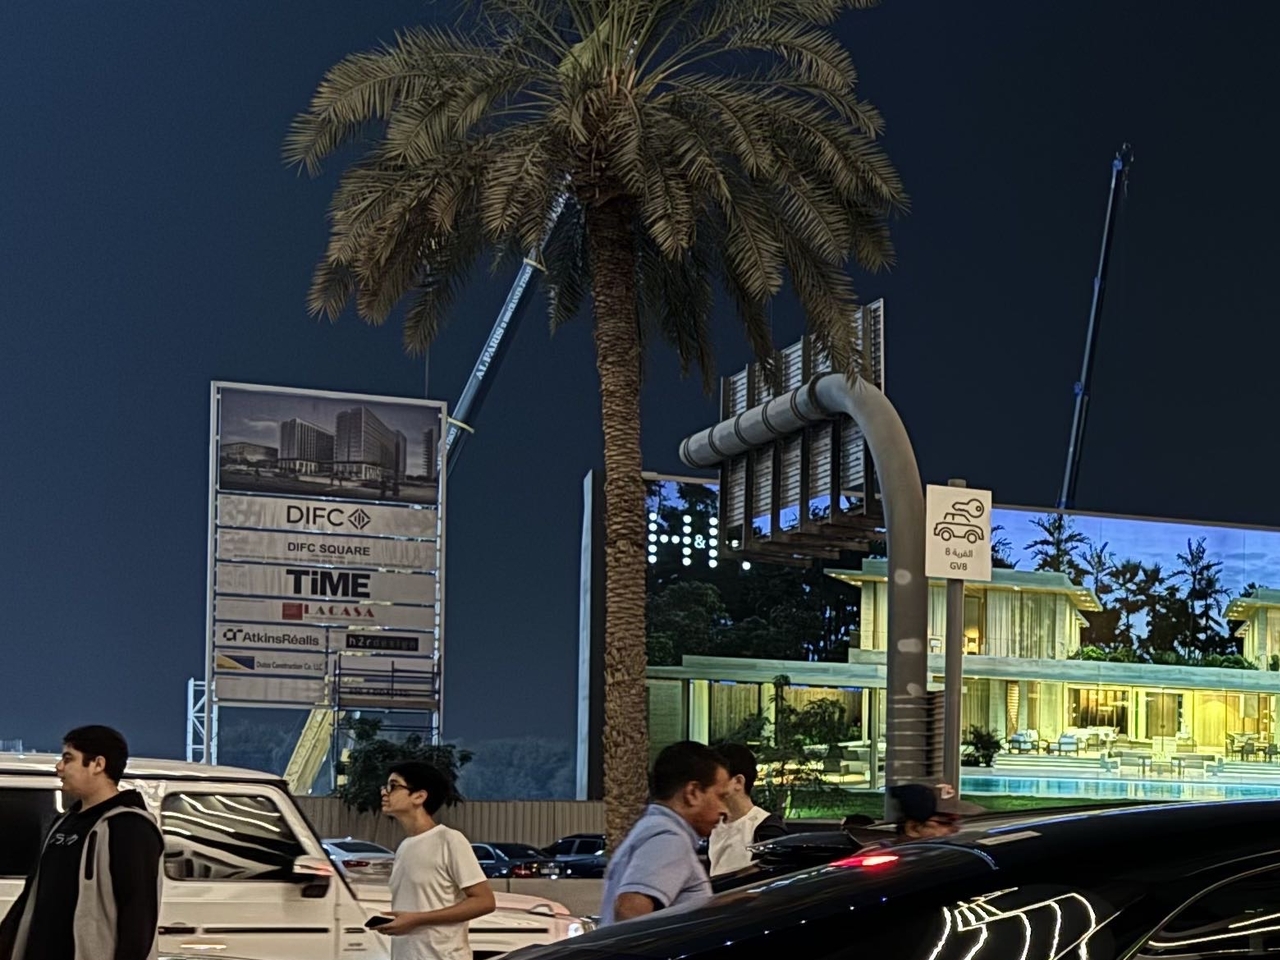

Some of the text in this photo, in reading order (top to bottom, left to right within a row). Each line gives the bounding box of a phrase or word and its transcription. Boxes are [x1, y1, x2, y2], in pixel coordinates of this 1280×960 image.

[286, 505, 345, 527] DIFC
[287, 541, 371, 556] DIFC SQUARE
[286, 568, 371, 599] TiME
